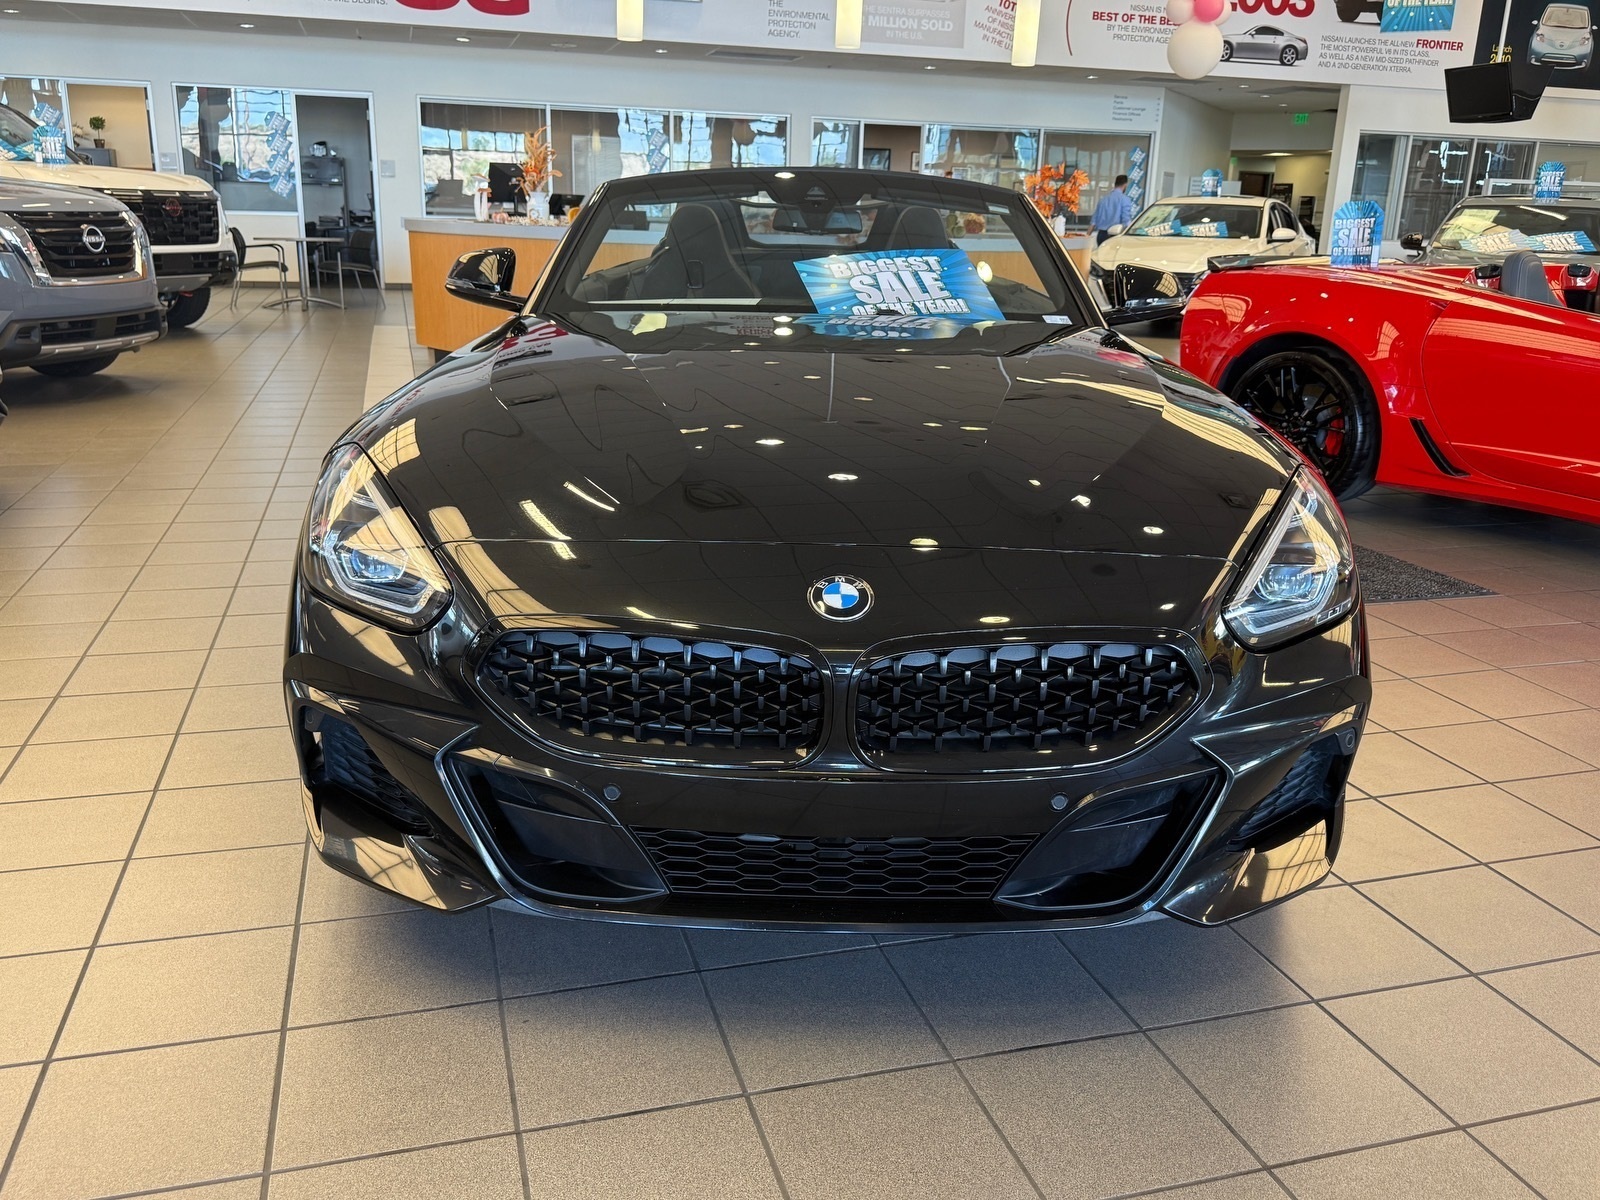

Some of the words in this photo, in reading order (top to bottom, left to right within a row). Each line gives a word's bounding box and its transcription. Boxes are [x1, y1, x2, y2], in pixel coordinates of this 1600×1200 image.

[877, 6, 906, 16] SENTRA
[999, 0, 1017, 12] 10T
[1130, 4, 1154, 13] NISSAN
[768, 9, 830, 20] ENVIRONMENTAL
[984, 4, 1016, 22] ANNIVERS
[1092, 11, 1120, 22] BEST
[1121, 13, 1136, 23] OF
[1138, 14, 1158, 24] THE
[768, 19, 816, 30] PROTECTION
[868, 15, 918, 29] MILLION
[921, 19, 954, 32] SOLD
[998, 19, 1014, 32] NISS
[1106, 24, 1116, 32] BY
[1131, 26, 1176, 35] ENVIRONMENT
[768, 29, 800, 38] AGENCY.
[974, 20, 1014, 42] MANUFACTU
[1112, 34, 1154, 42] PROTECTION
[1155, 36, 1169, 44] AGE
[1321, 34, 1344, 43] NISSAN
[1344, 36, 1376, 45] LAUNCHES
[1416, 38, 1464, 52] FRONTIER
[1333, 44, 1350, 52] MOST
[1351, 45, 1384, 54] POWERFUL
[1376, 56, 1404, 64] MID-SIZED
[1404, 58, 1440, 66] PATHFINDER
[1490, 54, 1512, 64] 210
[1541, 176, 1560, 187] SALE
[1334, 218, 1376, 230] BIGGEST
[1338, 228, 1371, 248] SALE
[1332, 248, 1343, 256] OF
[1344, 247, 1356, 256] THE
[829, 256, 942, 279] BIGGEST
[850, 270, 952, 304] SALE
[914, 298, 970, 314] YEAR!
[816, 576, 864, 590] BMW
